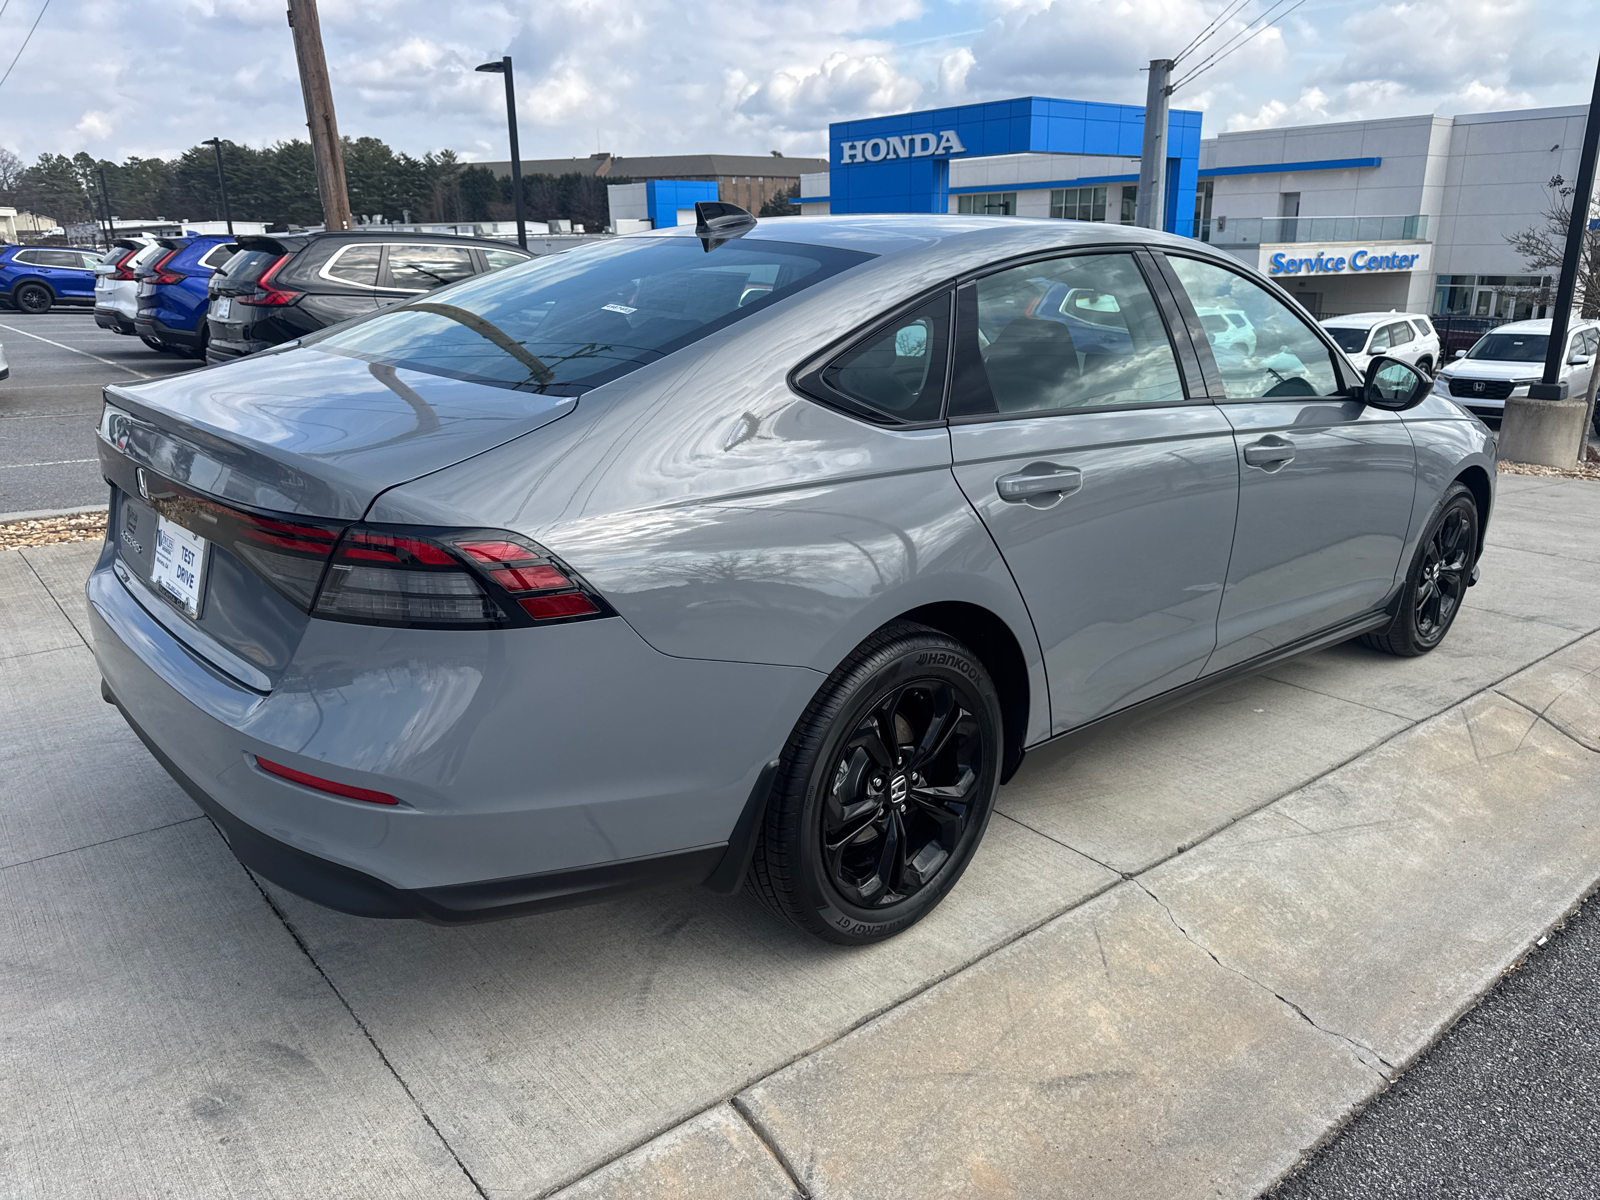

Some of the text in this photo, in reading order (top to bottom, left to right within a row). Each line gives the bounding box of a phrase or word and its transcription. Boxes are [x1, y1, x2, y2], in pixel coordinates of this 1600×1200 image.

[841, 130, 966, 164] HONDA
[1271, 250, 1419, 274] Service Center
[181, 545, 195, 567] TEST
[176, 564, 195, 589] DRIVE
[835, 916, 851, 928] GT
